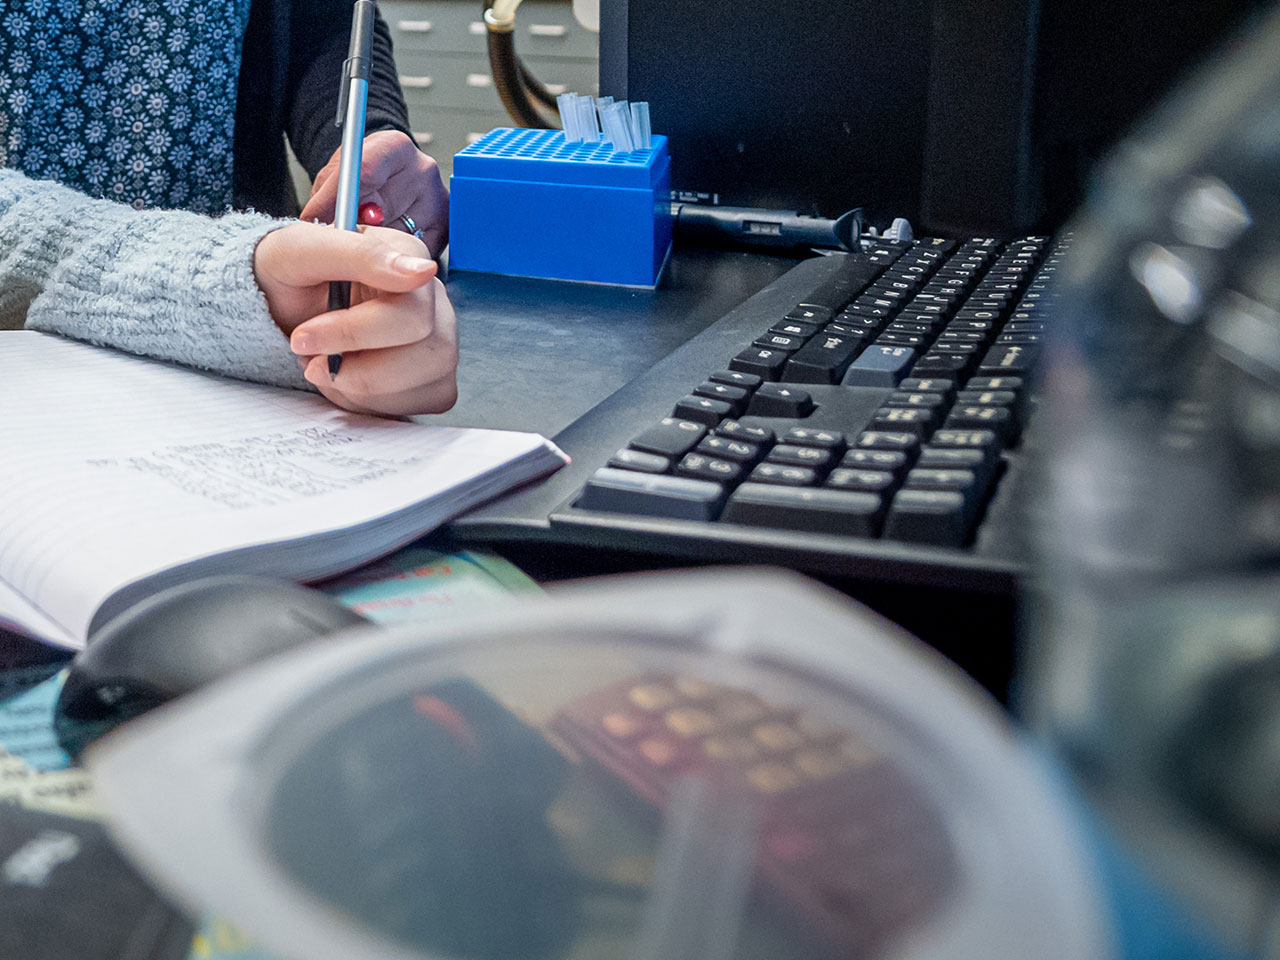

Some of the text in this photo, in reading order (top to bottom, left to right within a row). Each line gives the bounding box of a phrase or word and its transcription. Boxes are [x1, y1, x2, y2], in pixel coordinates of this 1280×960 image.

[883, 290, 900, 298] N
[874, 298, 892, 307] M
[678, 421, 700, 432] 0
[727, 441, 751, 455] 2
[709, 459, 733, 474] 3
